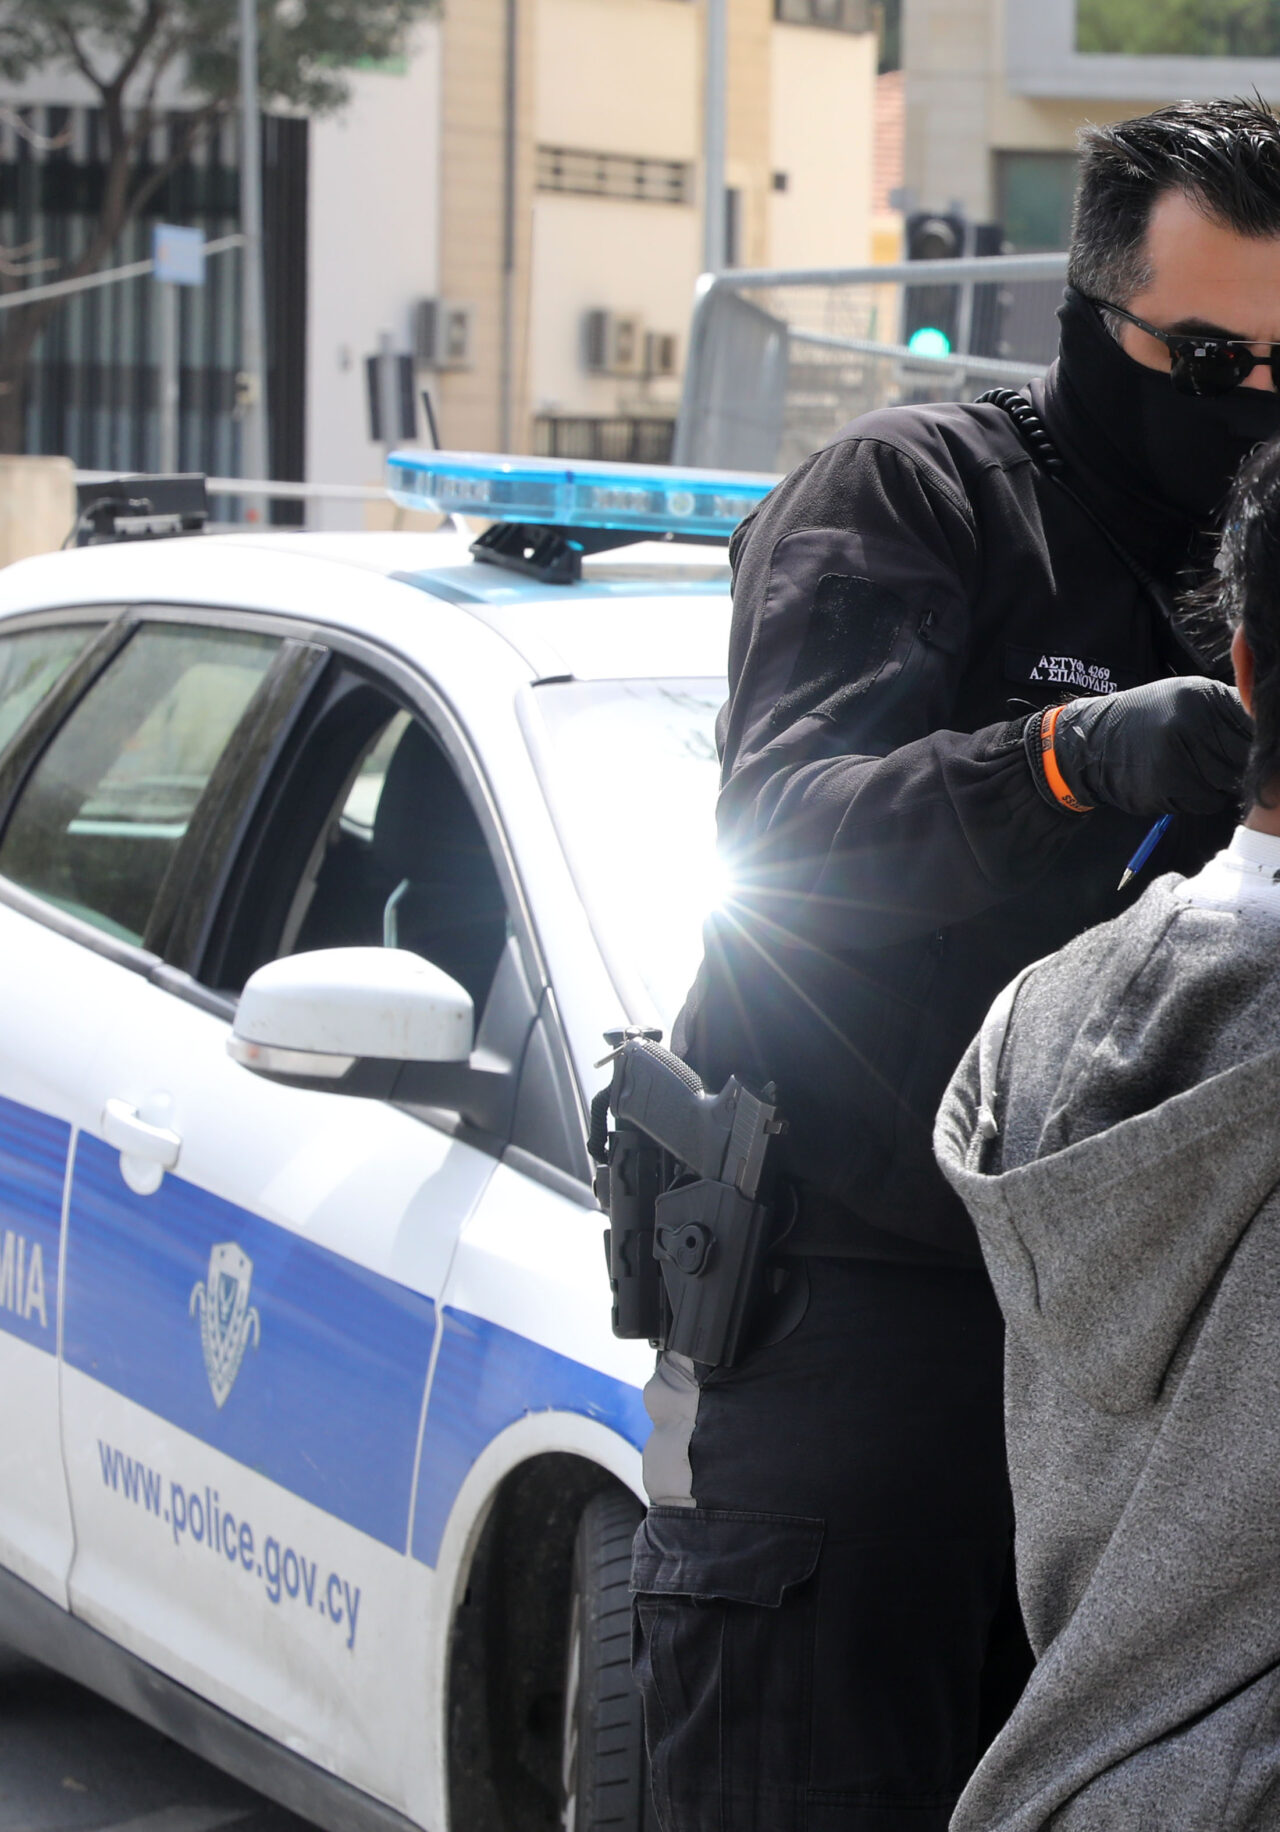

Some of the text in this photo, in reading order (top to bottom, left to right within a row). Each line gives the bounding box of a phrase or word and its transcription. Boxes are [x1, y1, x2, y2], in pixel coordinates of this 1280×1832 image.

[1029, 667, 1117, 694] Α. ΣΠΑΝΟΥΔΗΣ
[1088, 665, 1110, 680] 4269
[97, 1437, 361, 1651] www.police.gov.cy
